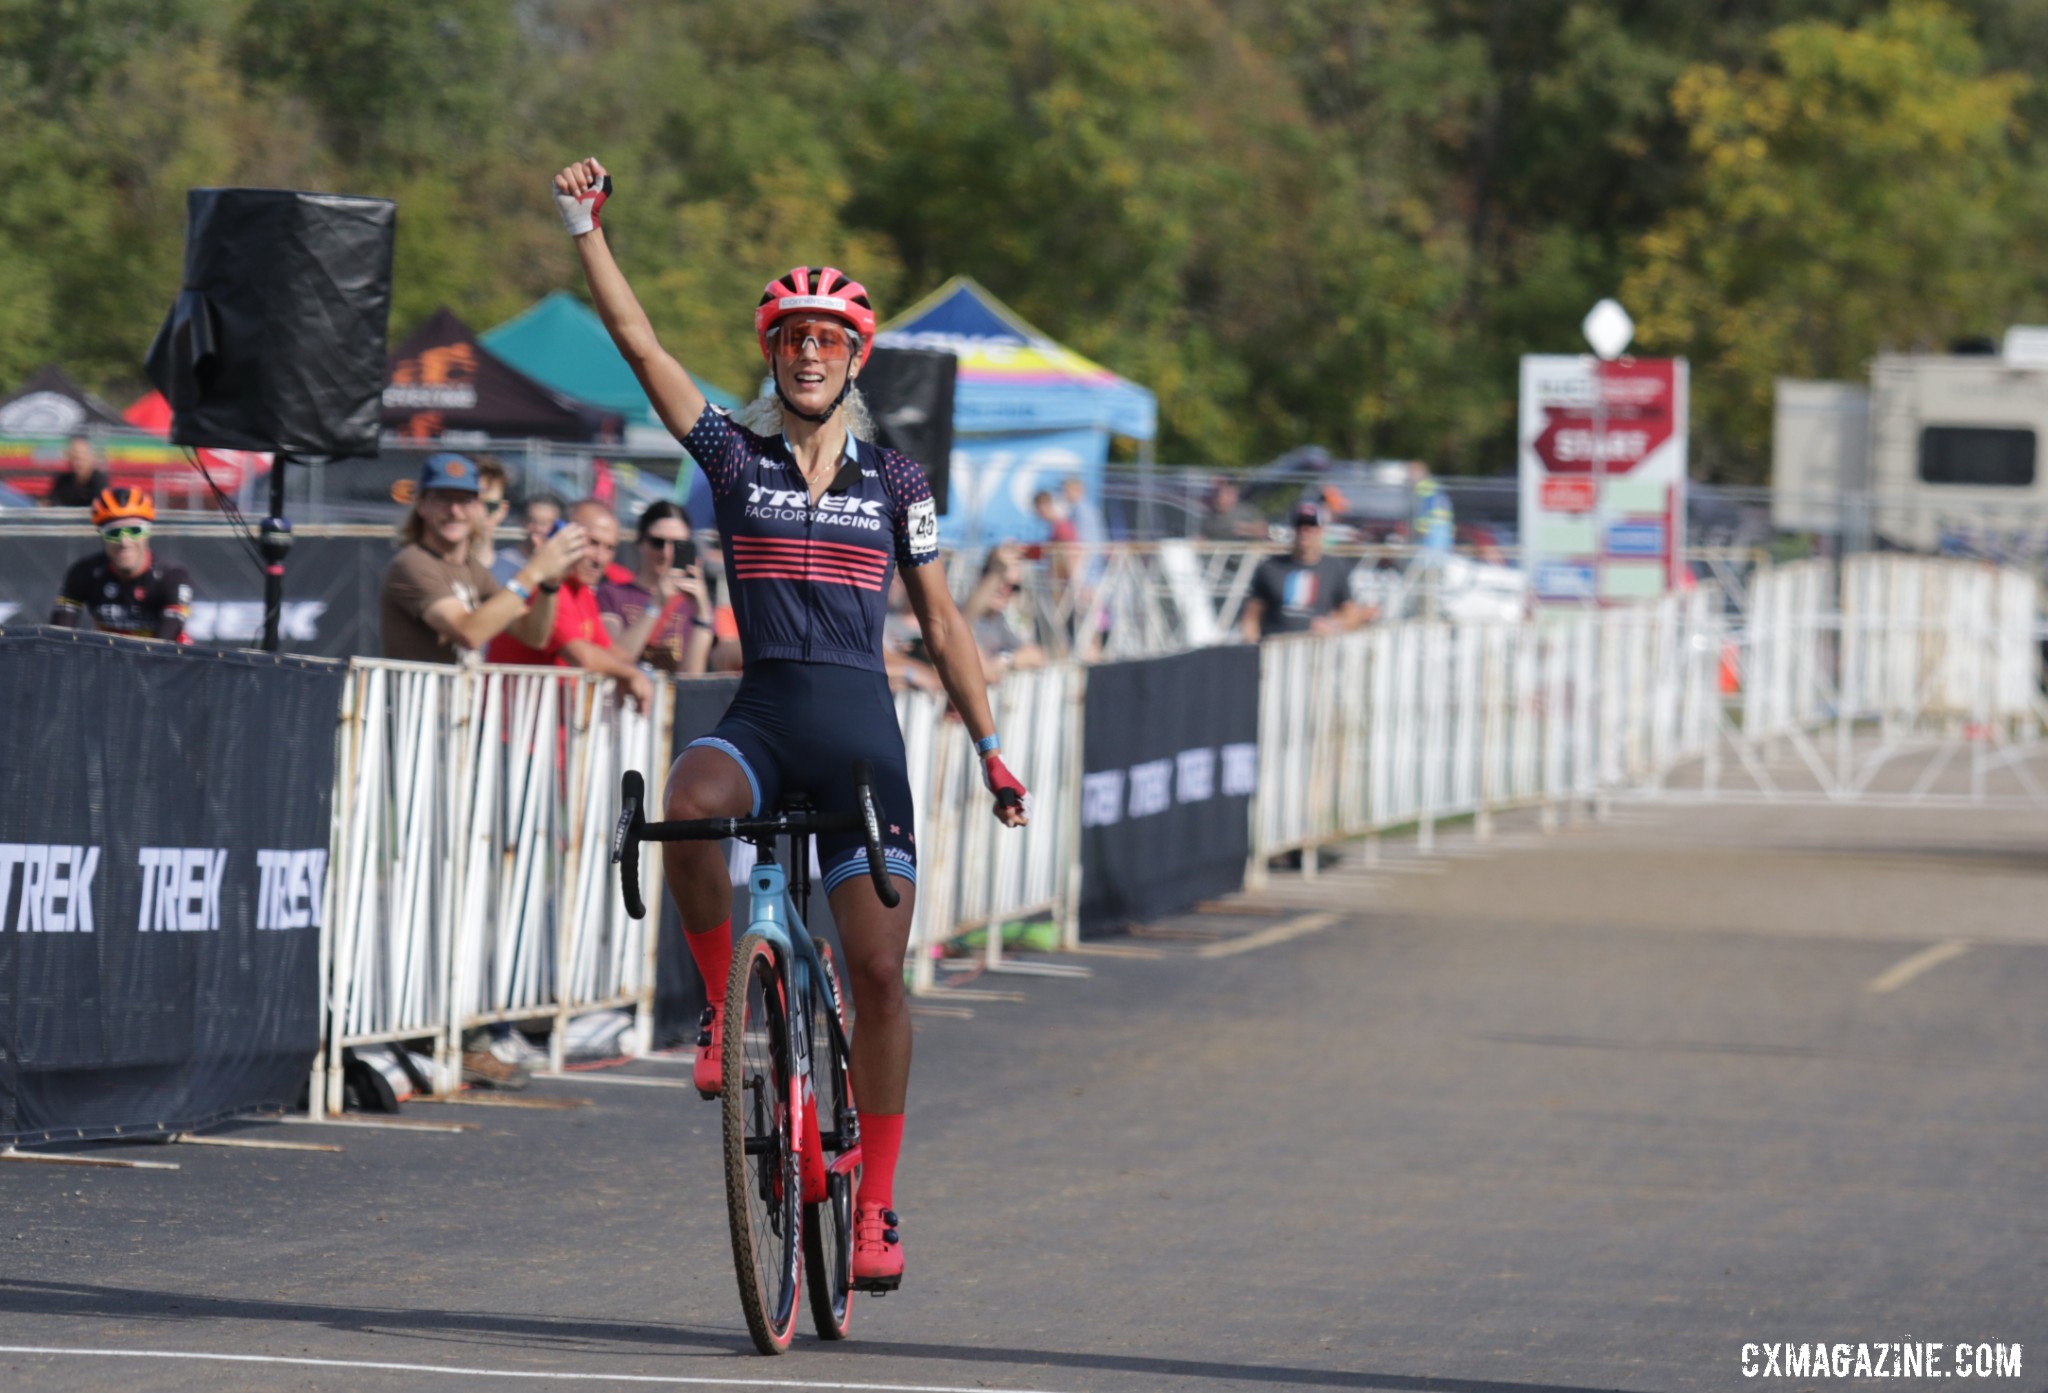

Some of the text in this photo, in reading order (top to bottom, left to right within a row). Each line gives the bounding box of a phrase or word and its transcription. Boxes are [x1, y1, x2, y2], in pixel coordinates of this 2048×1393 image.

[748, 482, 883, 517] TREK
[816, 511, 881, 531] RACING
[916, 512, 935, 538] 45
[853, 846, 913, 862] Sntini
[0, 843, 327, 932] TREK TREK TREK
